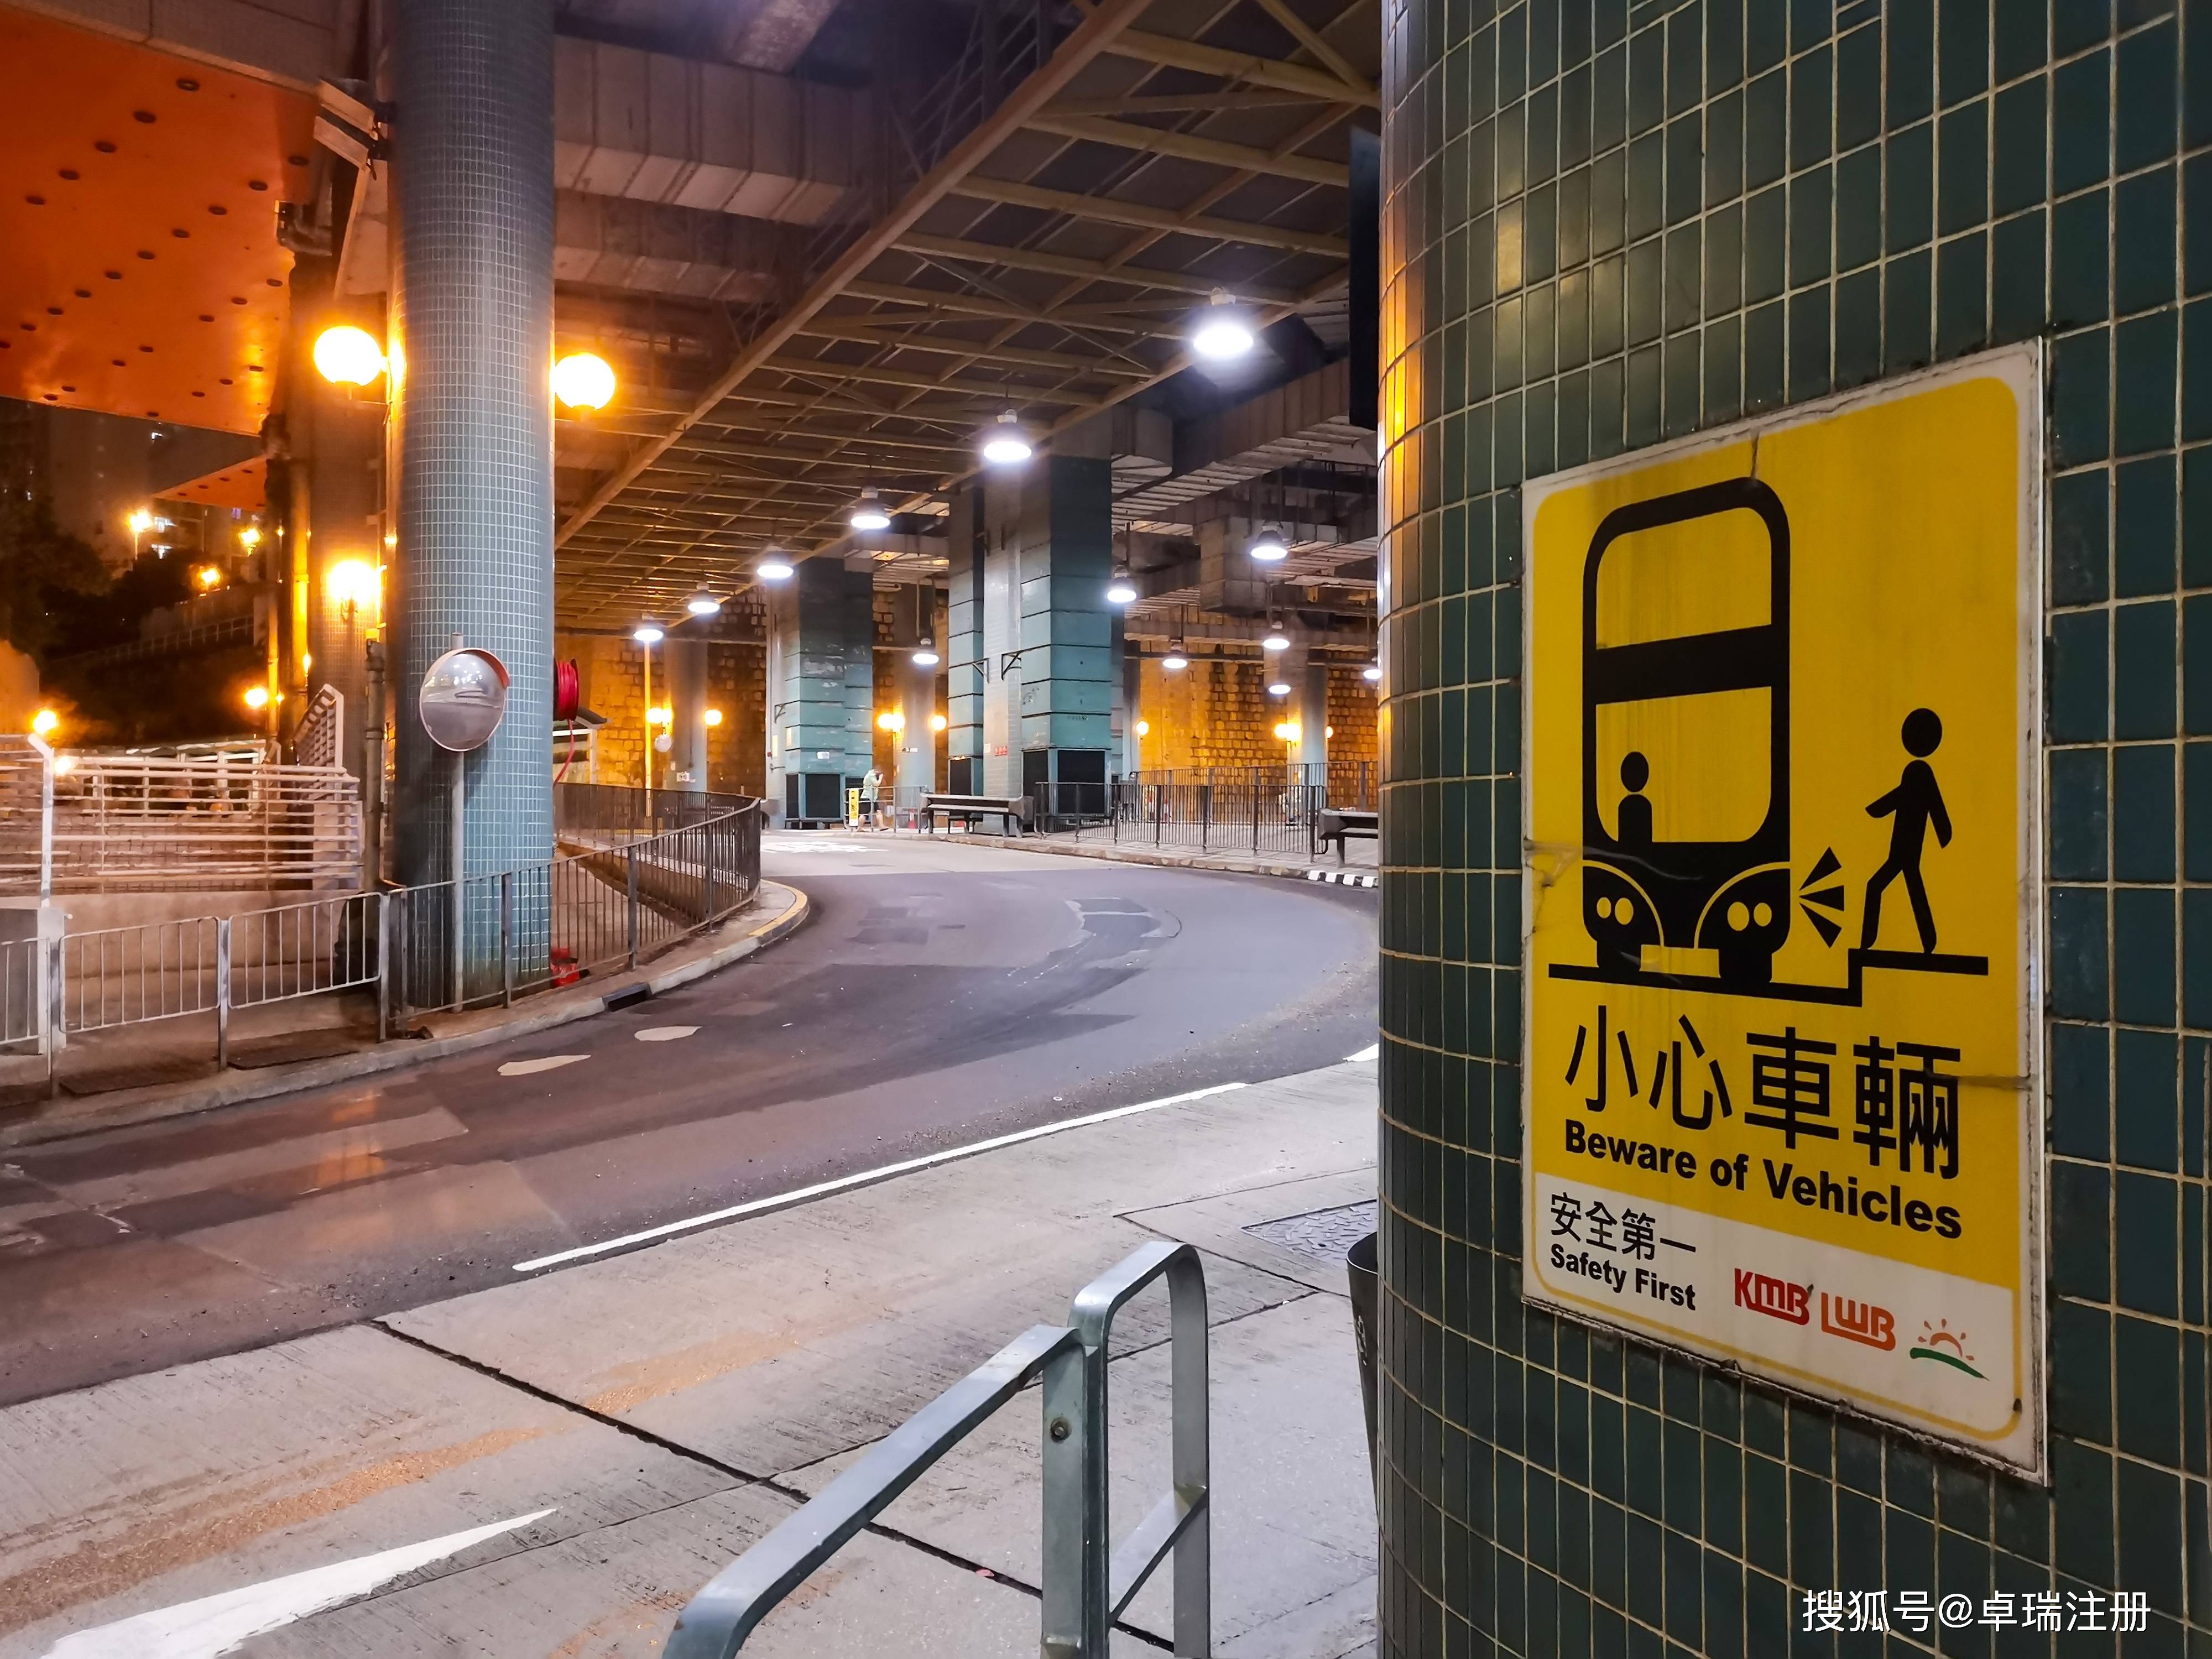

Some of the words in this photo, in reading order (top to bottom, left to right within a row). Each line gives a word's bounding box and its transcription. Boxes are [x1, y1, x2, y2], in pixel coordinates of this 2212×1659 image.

[1564, 1004, 1961, 1180] 小心車輛
[1566, 1119, 1697, 1178] Beware
[1709, 1153, 1749, 1191] of
[1762, 1158, 1963, 1239] Vehicles
[1551, 1192, 1696, 1260] 安全第一
[1551, 1243, 1627, 1293] Safety
[1635, 1267, 1696, 1311] First
[1734, 1268, 1809, 1326] KMB
[1821, 1292, 1896, 1351] LWB
